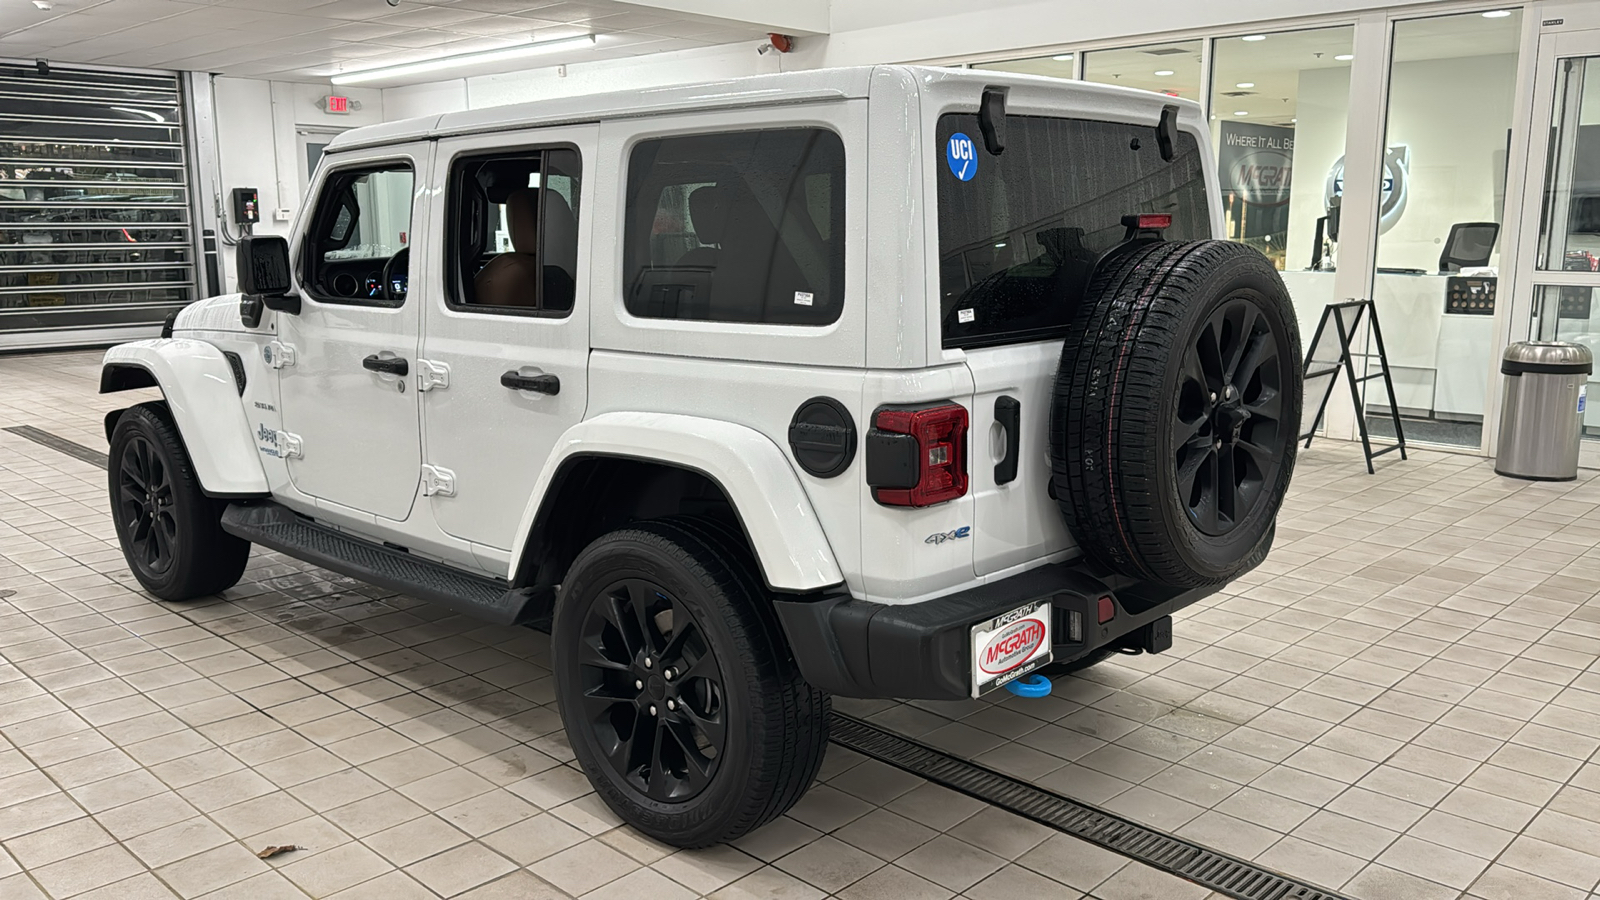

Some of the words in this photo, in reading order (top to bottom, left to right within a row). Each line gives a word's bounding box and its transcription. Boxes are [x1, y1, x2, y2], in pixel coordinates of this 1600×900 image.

[330, 96, 347, 112] EXIT
[950, 138, 973, 161] UCI
[1226, 133, 1257, 148] WHERE
[1258, 135, 1266, 148] IT
[1266, 136, 1282, 150] ALL
[1283, 137, 1294, 150] BE
[1237, 164, 1292, 187] McGRAT
[998, 650, 1022, 665] Automotive
[1021, 643, 1035, 654] Group
[995, 662, 1036, 686] GoMcGrath.com
